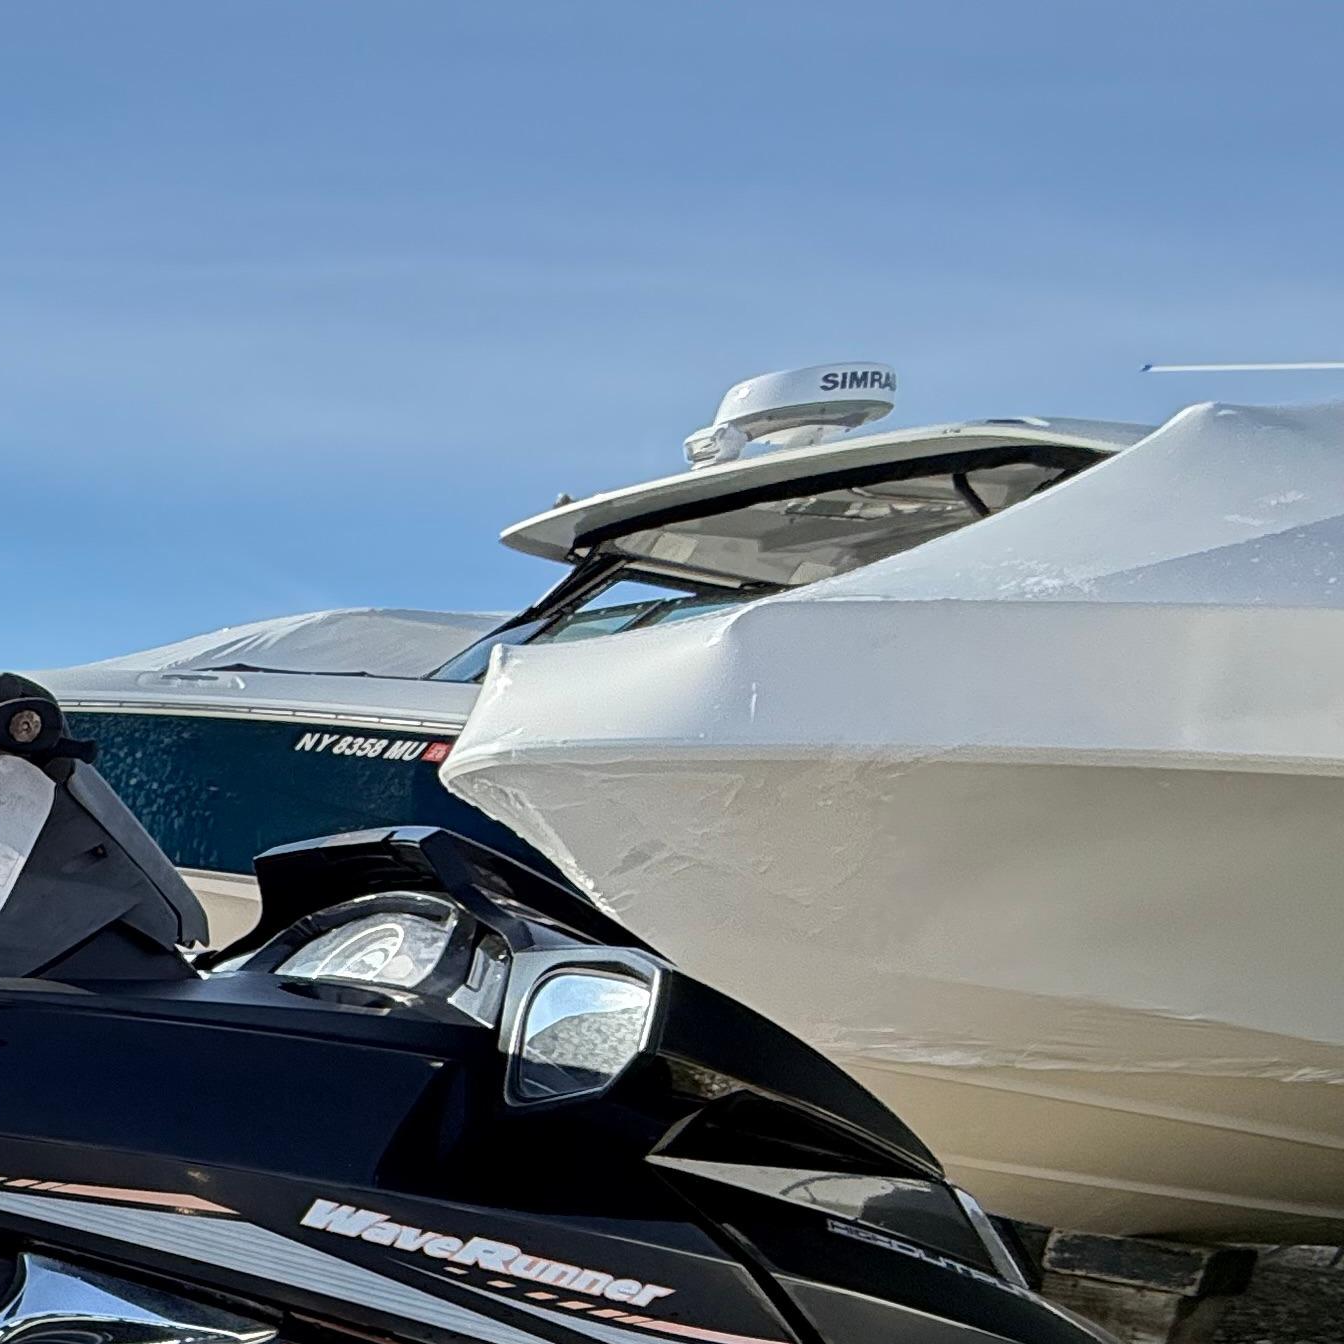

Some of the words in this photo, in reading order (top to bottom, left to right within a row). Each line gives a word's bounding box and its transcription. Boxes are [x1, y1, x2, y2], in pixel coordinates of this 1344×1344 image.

[295, 732, 340, 752] NY
[332, 736, 389, 758] 8358
[383, 740, 428, 761] MU
[299, 1197, 677, 1308] WaveRunner
